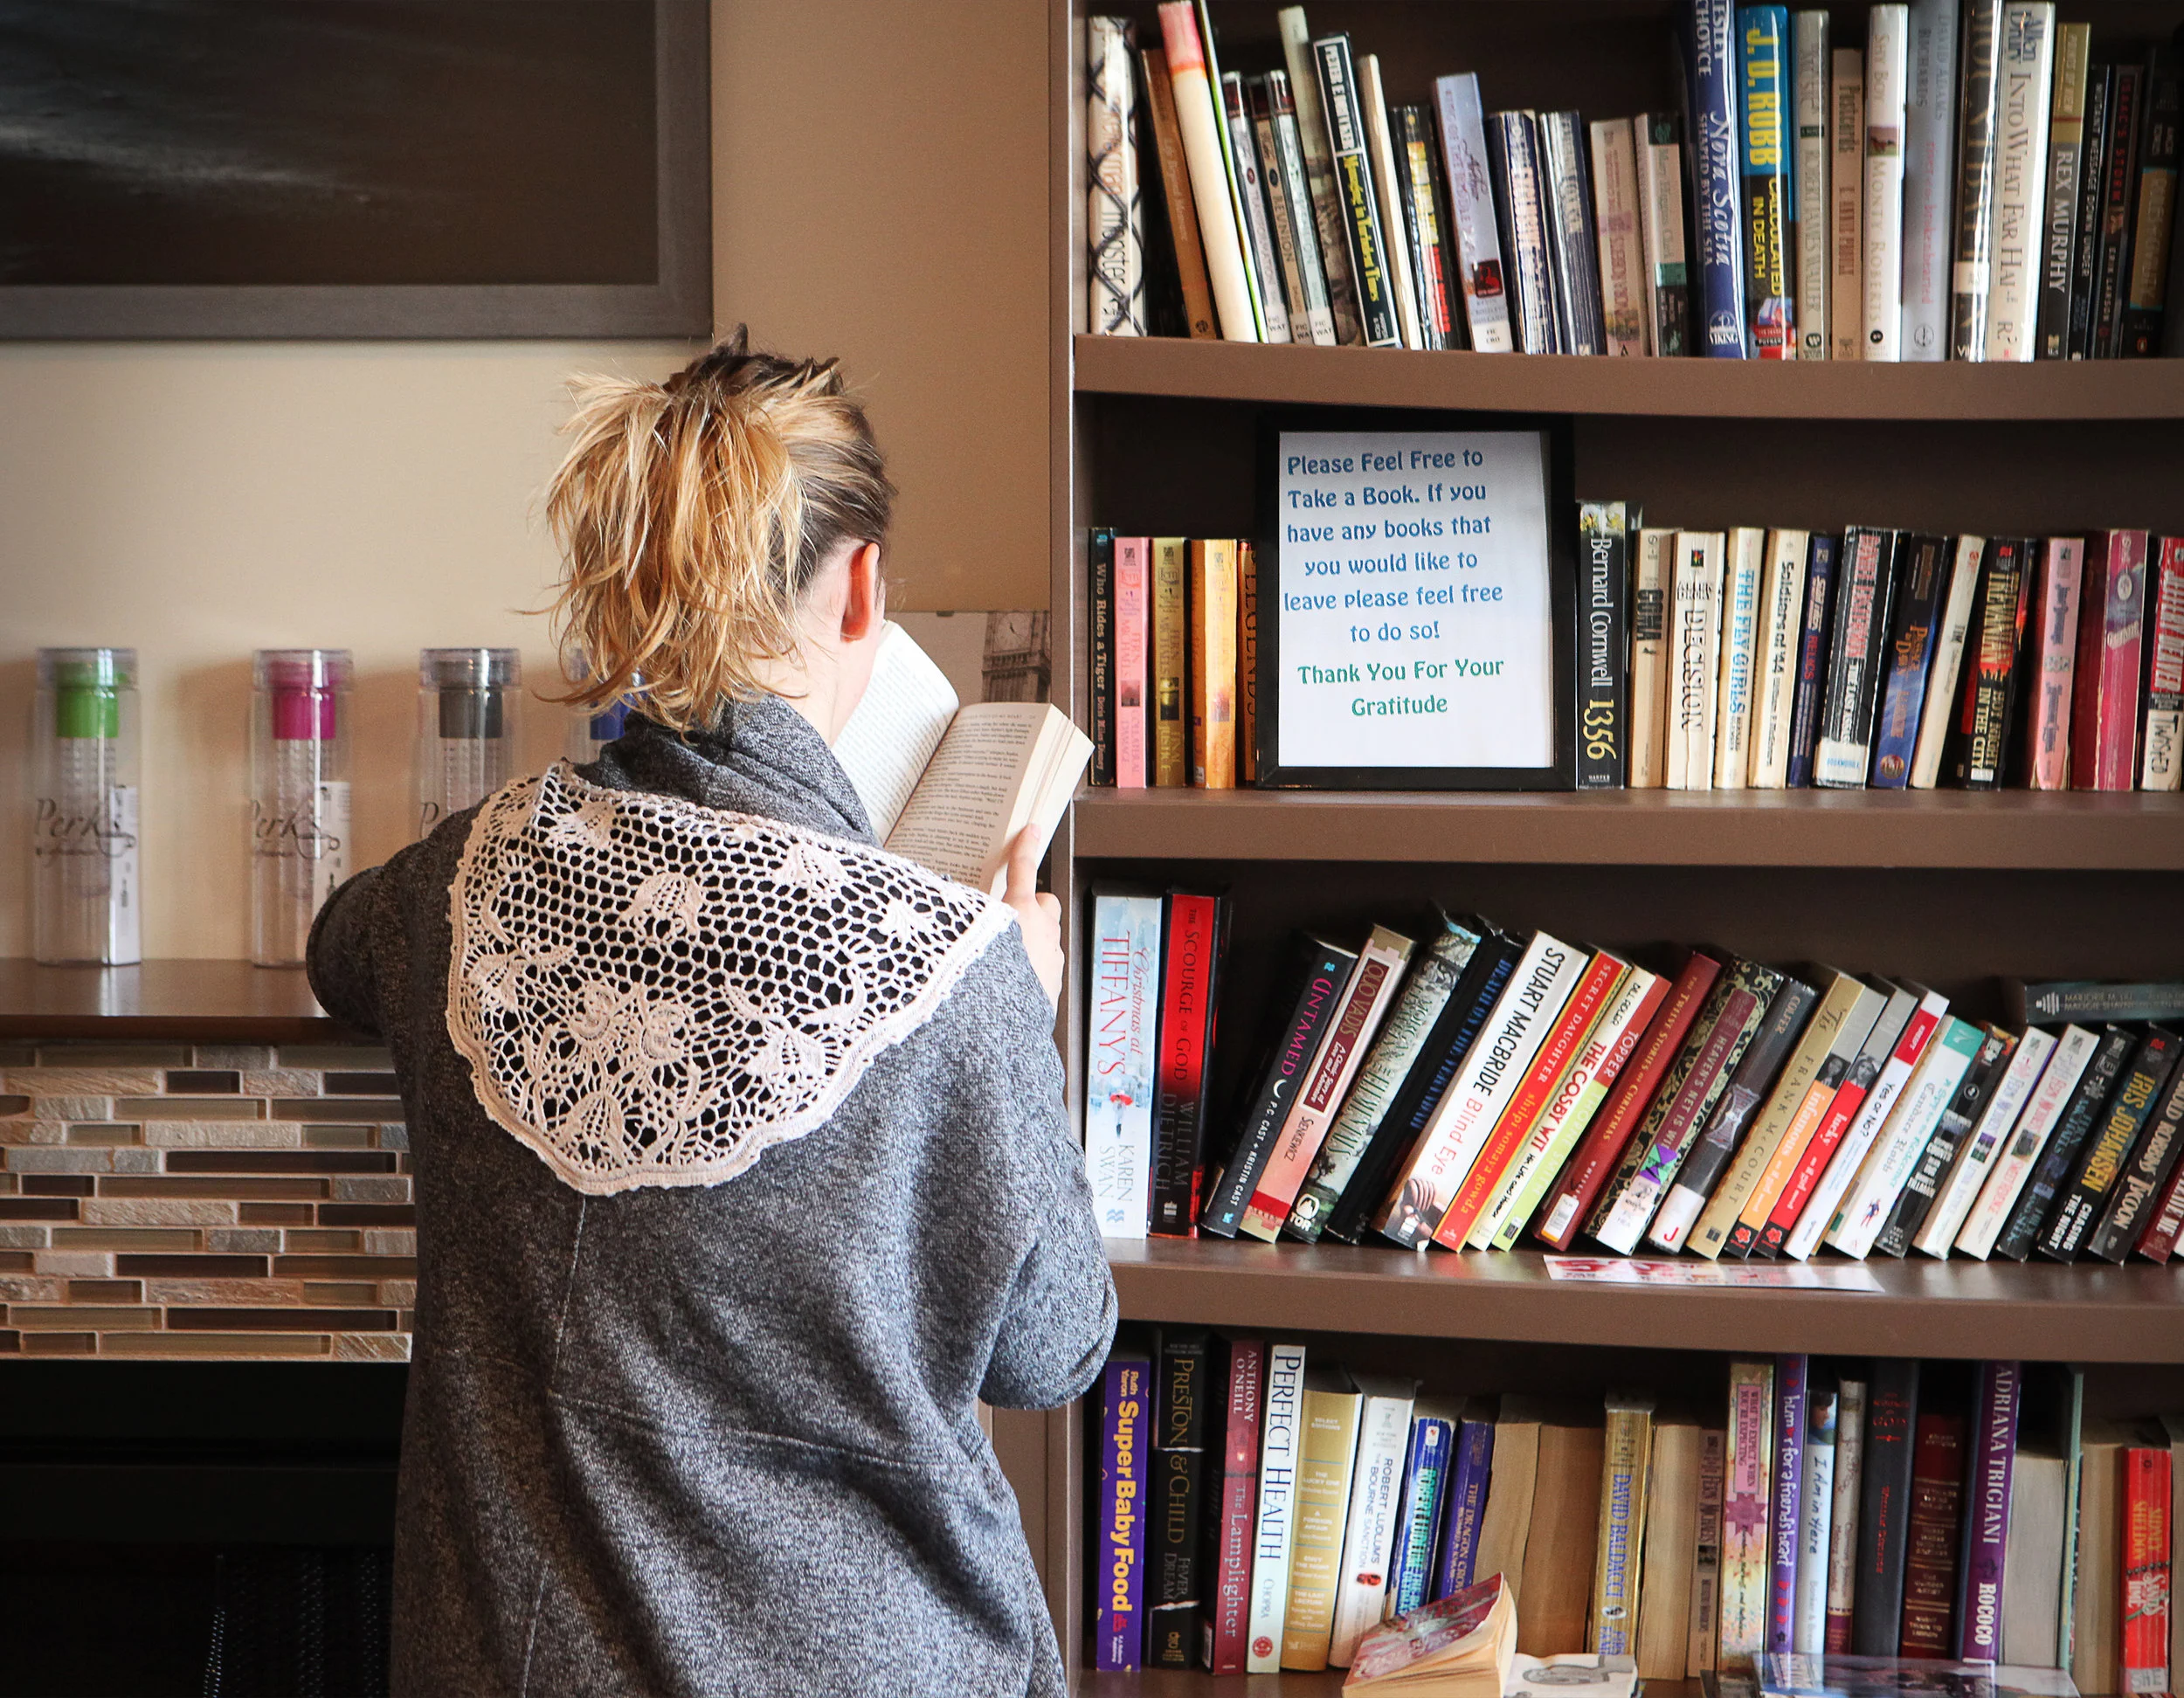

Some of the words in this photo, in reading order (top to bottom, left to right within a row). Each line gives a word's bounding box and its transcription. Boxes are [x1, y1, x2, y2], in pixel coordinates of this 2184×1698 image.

[1710, 111, 1731, 180] Nova
[1748, 93, 1783, 166] ROBB
[2055, 150, 2075, 190] REX
[1271, 195, 1296, 263] REUNION
[1711, 189, 1732, 266] Scotia
[1752, 196, 1766, 217] IN
[1752, 219, 1766, 279] DEATH
[1768, 177, 1784, 296] CALCULATED
[2048, 198, 2072, 293] MURPHY
[1869, 241, 1890, 323] ROBERTS
[1288, 456, 1353, 475] Please
[1361, 452, 1403, 473] Feel
[1411, 451, 1455, 470] Free
[1462, 450, 1482, 467] to
[1288, 490, 1336, 508] Take
[1344, 493, 1355, 506] a
[1363, 486, 1420, 505] Book.
[1427, 484, 1442, 502] If
[1450, 484, 1487, 500] you
[1288, 524, 1334, 542] have
[1342, 523, 1376, 540] any
[1385, 519, 1443, 538] books
[1451, 516, 1490, 535] that
[1095, 563, 1107, 596] Who
[1305, 560, 1340, 576] you
[1348, 554, 1406, 574] would
[1415, 552, 1450, 571] like
[1457, 553, 1477, 569] to
[1590, 538, 1614, 607] Bernard
[1284, 593, 1337, 611] leave
[1344, 590, 1408, 608] please
[1417, 586, 1454, 606] feel
[1462, 585, 1503, 603] free
[1735, 569, 1755, 611] THE
[1095, 599, 1108, 638] Rides
[1350, 625, 1370, 643] to
[1378, 624, 1401, 641] do
[1410, 622, 1440, 639] so!
[1636, 589, 1664, 641] COMA
[1733, 615, 1752, 651] FLY
[1093, 652, 1108, 691] Tiger
[1297, 664, 1361, 684] Thank
[1366, 662, 1406, 681] You
[1414, 661, 1448, 680] For
[1455, 659, 1503, 678] Your
[1589, 610, 1614, 687] Cornwell
[1682, 608, 1707, 733] DECISION
[1803, 635, 1819, 680] RELICS
[1351, 695, 1448, 716] Gratitude
[1729, 652, 1749, 715] GIRLS
[1978, 687, 1992, 705] IN
[1582, 698, 1617, 761] 1356
[1974, 707, 1990, 735] THE
[1971, 736, 1987, 769] CITY
[1130, 948, 1151, 1032] Christmas
[1178, 929, 1199, 1014] SCOURGE
[1358, 963, 1385, 997] QUO
[1521, 947, 1565, 1013] STUART
[1580, 964, 1612, 1011] SECRET
[1097, 930, 1130, 1076] TIFFANY'S
[1281, 977, 1332, 1076] UNTAMED
[1340, 999, 1372, 1038] VADIS
[1774, 995, 1800, 1035] COLFER
[1130, 1037, 1143, 1054] at
[1174, 1038, 1192, 1080] GOD
[1473, 1009, 1532, 1097] MACBRIDE
[1538, 1015, 1583, 1083] DAUGHTER
[1580, 1039, 1607, 1072] THE
[1603, 1030, 1640, 1079] TOPPER
[1695, 1036, 1727, 1087] HEAVEN'S
[1547, 1072, 1588, 1124] COSBY
[1681, 1091, 1698, 1114] NET
[1776, 1054, 1814, 1115] FRANK
[2123, 1072, 2156, 1109] IRIS
[1256, 1119, 1270, 1142] CAST
[1449, 1097, 1483, 1145] Blind
[1602, 1083, 1640, 1140] CHRISTMAS
[1674, 1114, 1684, 1128] IS
[1780, 1090, 1826, 1157] infamous
[1819, 1113, 1848, 1147] lucky
[1155, 1093, 1177, 1190] DIETRICH
[1174, 1101, 1195, 1187] WILLIAM
[1434, 1143, 1456, 1176] Eye
[1485, 1130, 1513, 1174] somaya
[2081, 1106, 2137, 1193] JOHANSEN
[1098, 1146, 1115, 1198] SWAN
[1117, 1144, 1135, 1201] KAREN
[1239, 1151, 1258, 1188] KRISTIN
[1460, 1173, 1486, 1214] gowda
[1230, 1187, 1244, 1206] CAST
[2064, 1194, 2082, 1216] THE
[1289, 1212, 1310, 1232] TOR
[2049, 1214, 2071, 1250] NIGHT
[2063, 1203, 2092, 1251] CHASING
[1121, 1370, 1130, 1397] Yaron
[1170, 1358, 1194, 1445] PRESTON
[1233, 1357, 1245, 1414] O'NEILL
[1244, 1349, 1256, 1422] ANTHONY
[1268, 1354, 1302, 1457] PERFECT
[1989, 1364, 2014, 1452] ADRIANA
[1114, 1400, 1139, 1478] Super
[1738, 1421, 1747, 1467] EXPECTING
[1748, 1430, 1759, 1460] EXPECT
[1170, 1455, 1187, 1474] &
[1379, 1458, 1393, 1508] ROBERT
[1747, 1462, 1757, 1487] WHEN
[1111, 1481, 1137, 1546] Baby
[1167, 1475, 1190, 1543] CHILD
[1234, 1485, 1246, 1508] The
[1259, 1467, 1293, 1559] HEALTH
[1365, 1466, 1379, 1515] BOURNE
[1468, 1483, 1479, 1508] THE
[1611, 1474, 1632, 1521] DAVID
[1982, 1456, 2007, 1544] TRIGIANI
[1358, 1518, 1373, 1569] SANCTION
[1371, 1512, 1386, 1563] LUDLUM'S
[1458, 1509, 1476, 1559] DRAGON
[1776, 1531, 1794, 1569] heart
[1809, 1517, 1823, 1554] Here
[2132, 1499, 2148, 1561] SHELDON
[1112, 1547, 1135, 1612] Food
[1163, 1552, 1178, 1599] DREAM
[1177, 1557, 1192, 1598] FEVER
[1223, 1513, 1248, 1637] Lamplighter
[1606, 1523, 1630, 1598] BALDACCI
[1261, 1578, 1276, 1619] CHOPRA
[1973, 1582, 1997, 1646] ROCOCO
